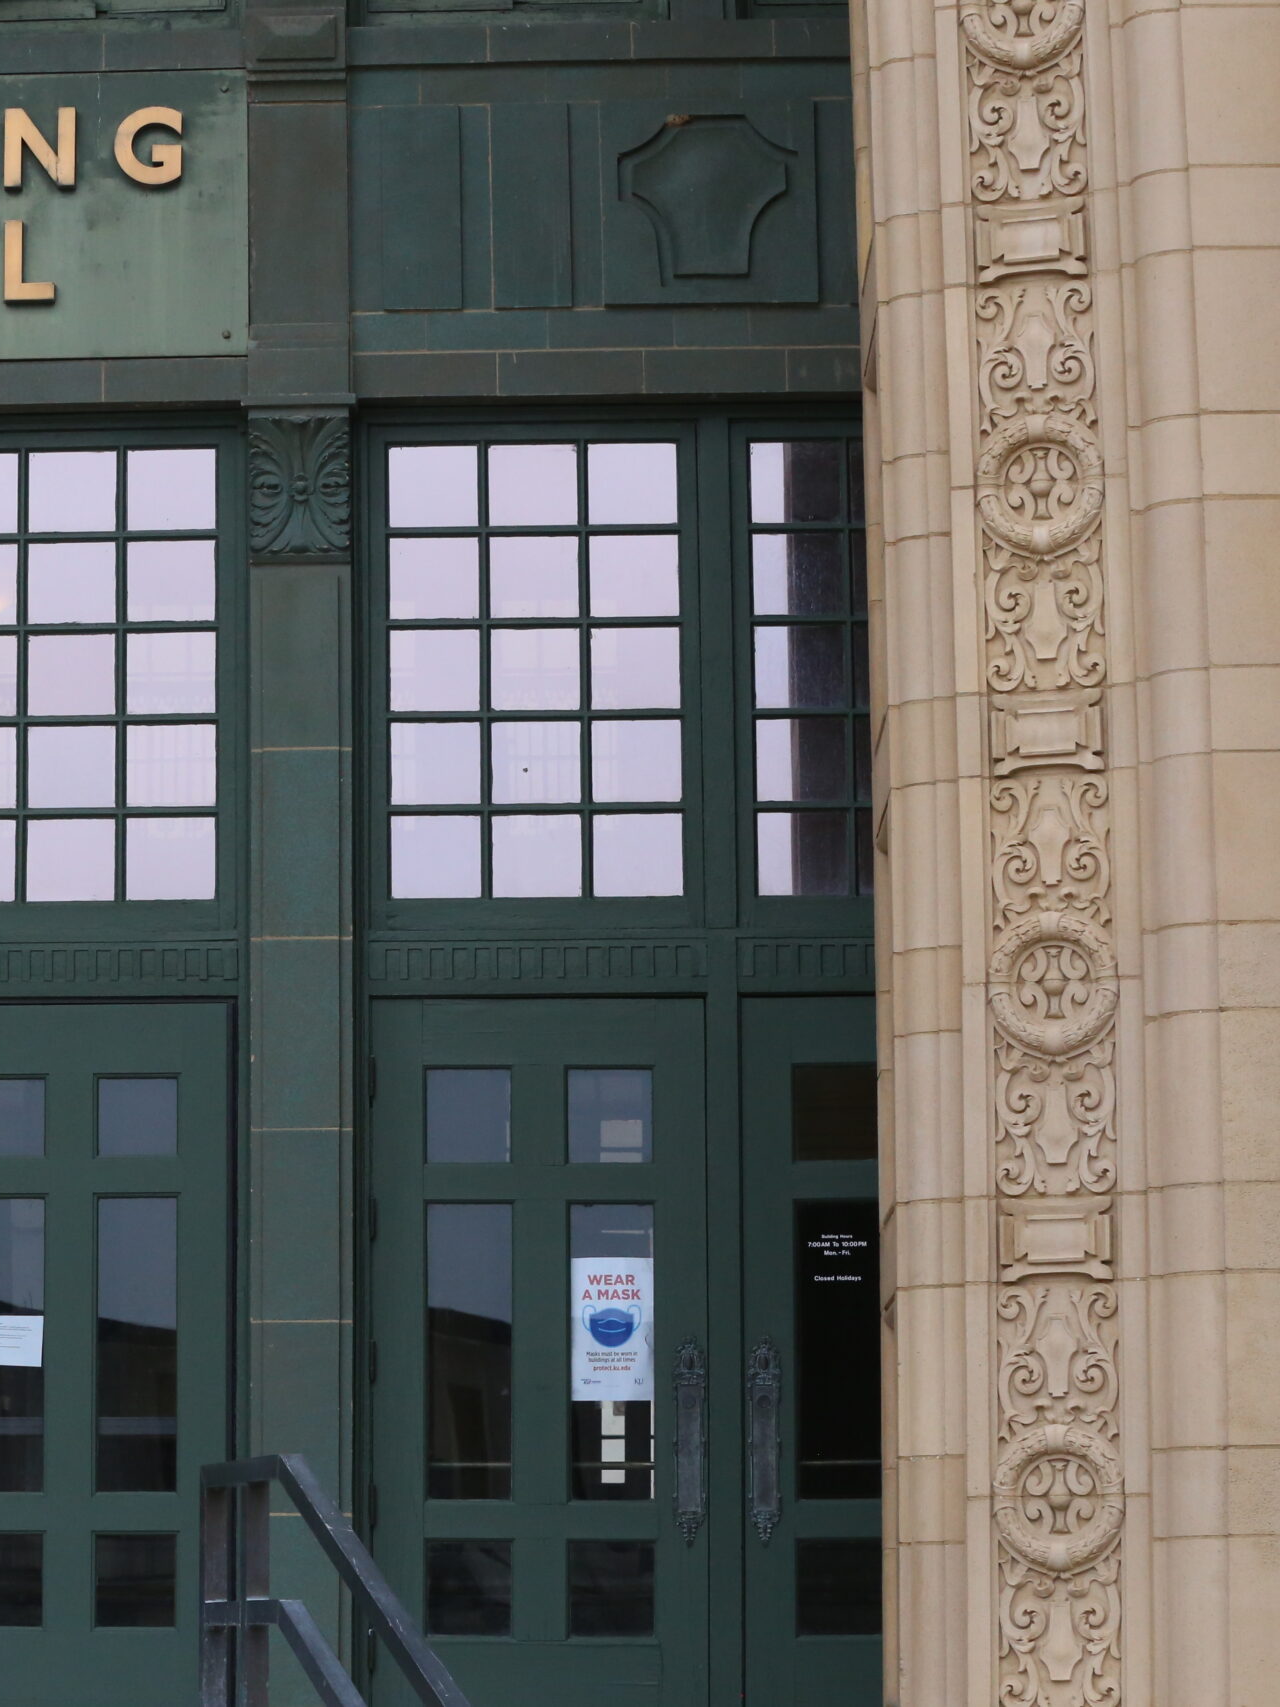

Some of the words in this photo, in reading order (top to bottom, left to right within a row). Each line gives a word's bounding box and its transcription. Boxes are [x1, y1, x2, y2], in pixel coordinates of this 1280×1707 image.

[587, 1274, 636, 1286] WEAR
[582, 1289, 593, 1301] A
[597, 1289, 641, 1301] MASK
